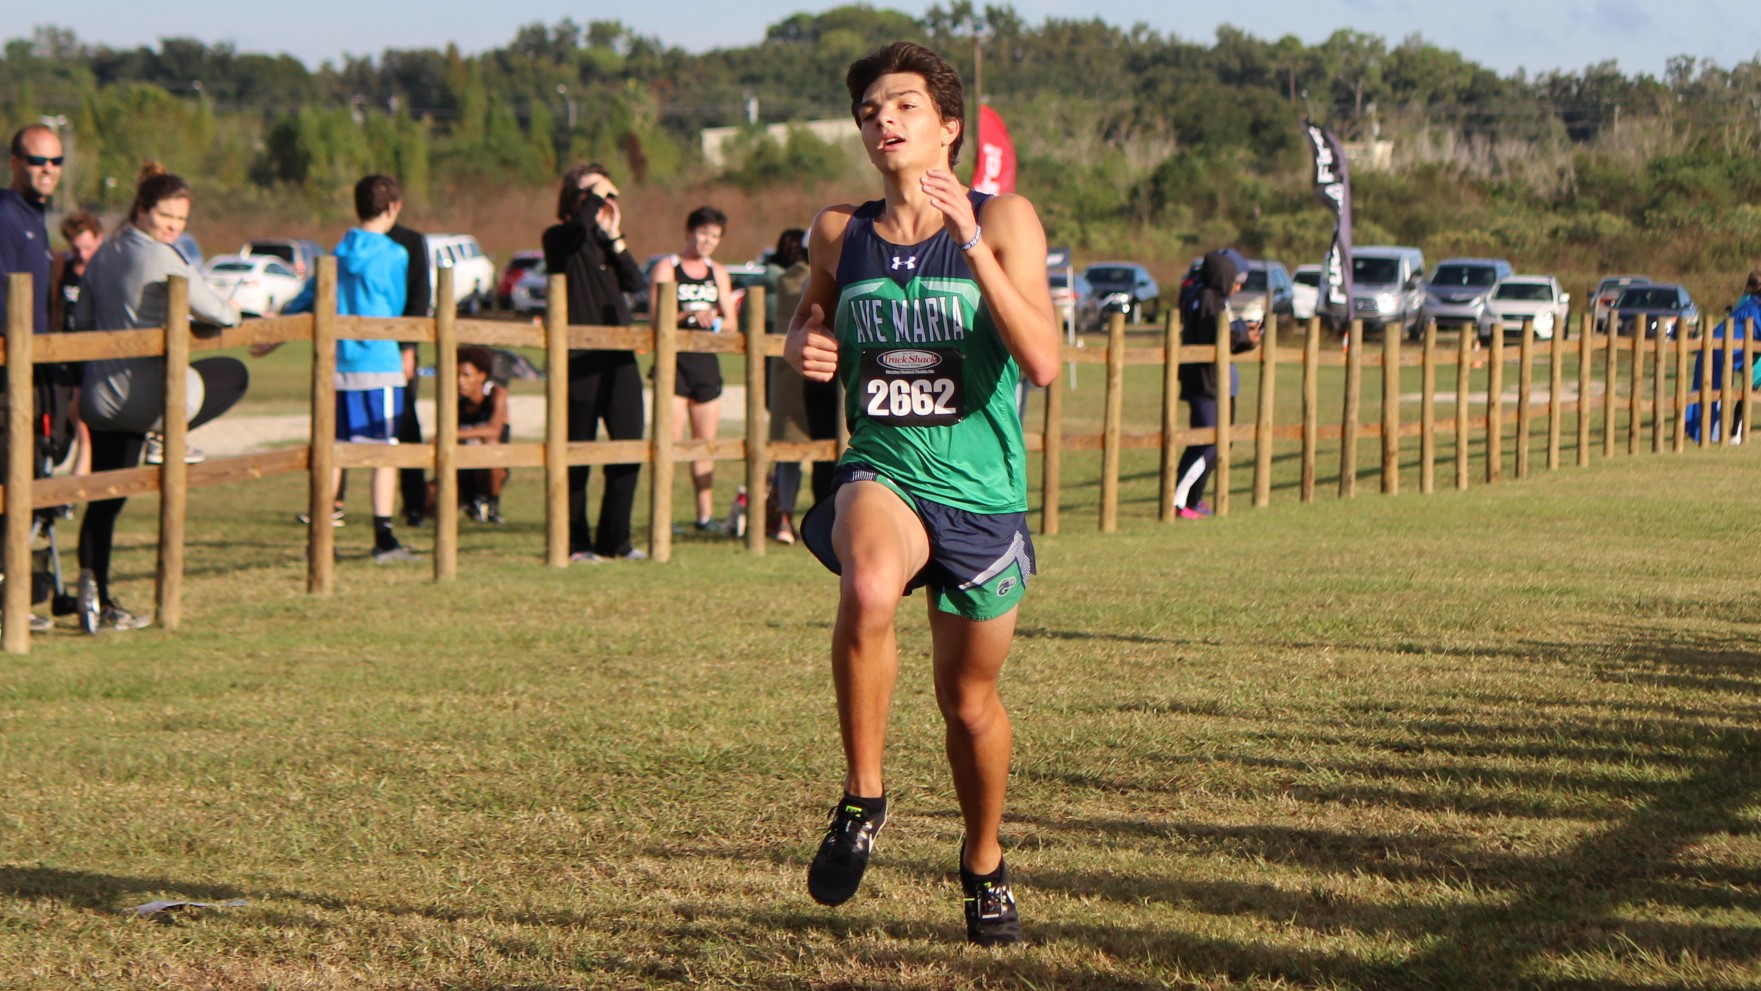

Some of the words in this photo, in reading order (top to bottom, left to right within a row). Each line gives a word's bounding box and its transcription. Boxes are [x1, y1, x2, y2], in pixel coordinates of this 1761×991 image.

[851, 300, 887, 343] AVE
[892, 295, 965, 343] MARIA
[883, 354, 908, 364] Track
[909, 354, 938, 364] Shack
[867, 378, 956, 416] 2662
